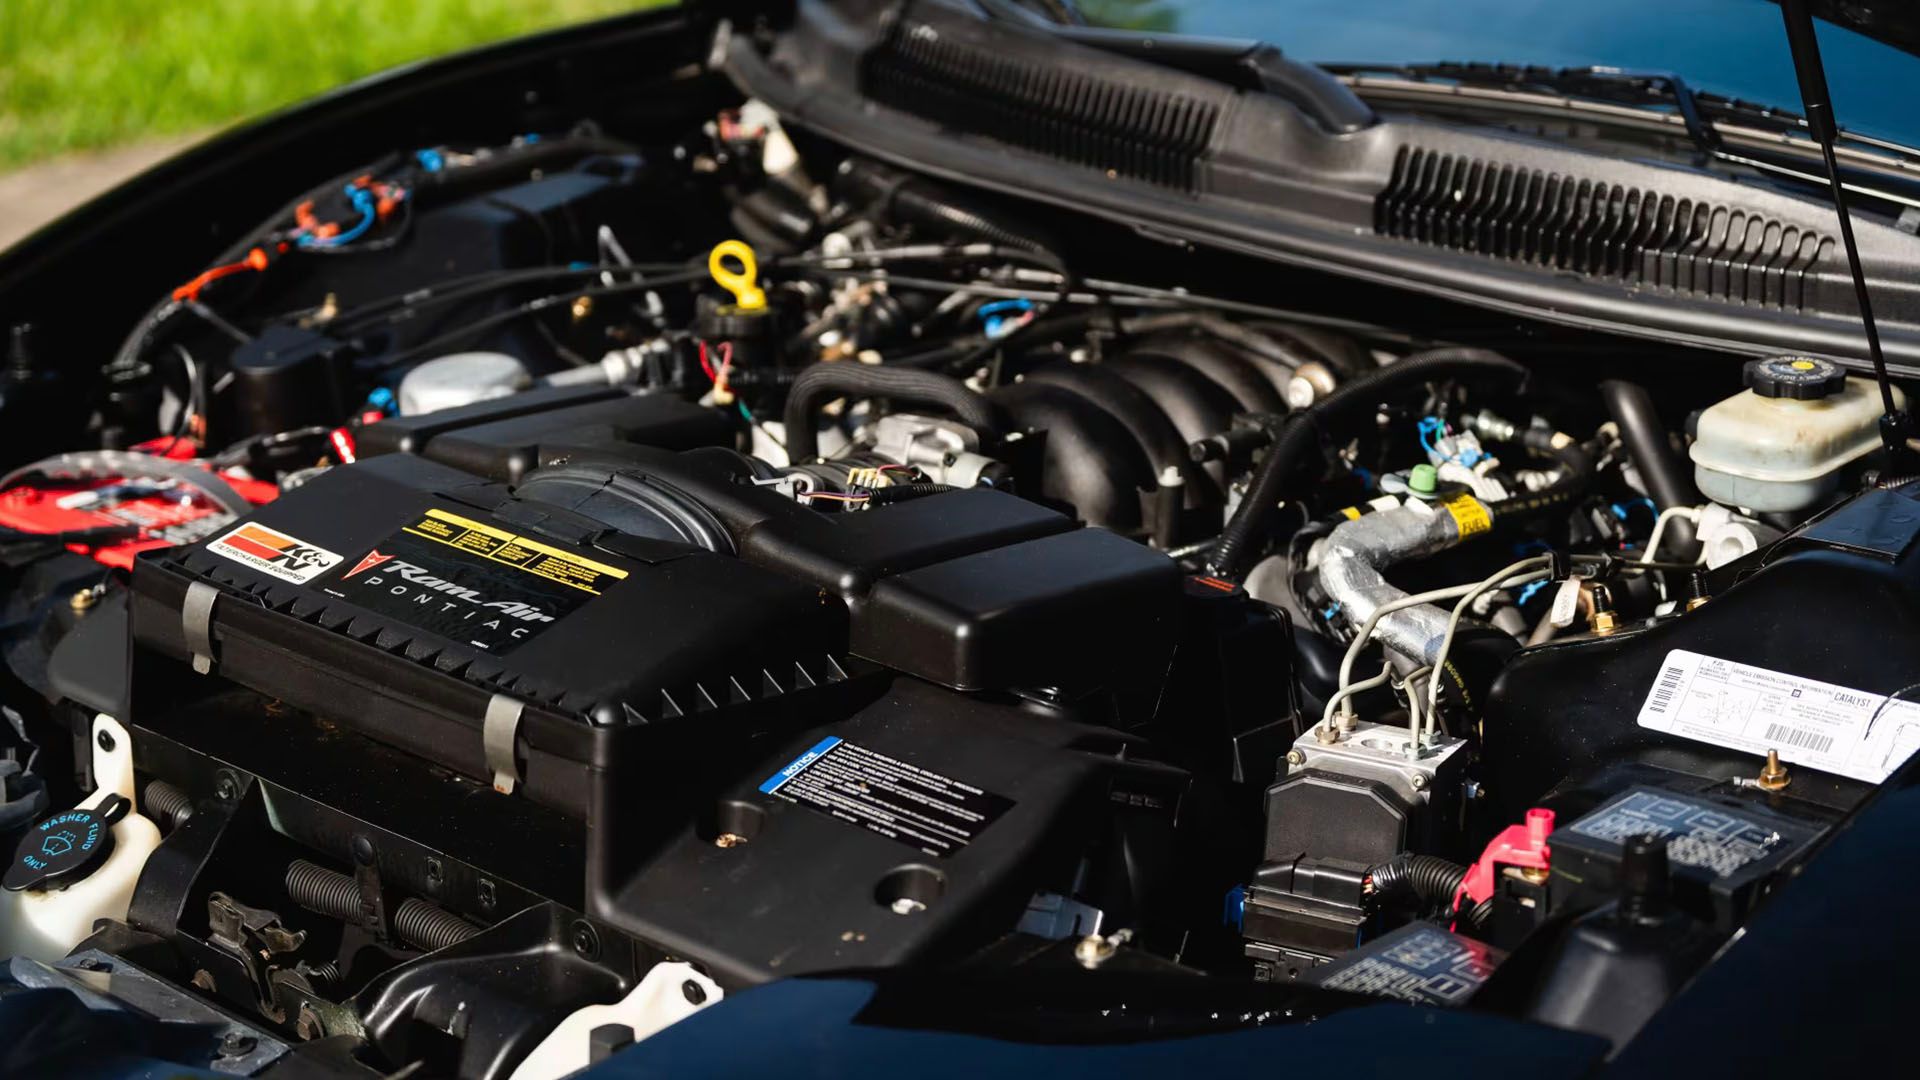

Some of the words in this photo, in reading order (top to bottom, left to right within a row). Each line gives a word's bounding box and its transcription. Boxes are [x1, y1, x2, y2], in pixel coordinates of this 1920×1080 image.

[1462, 518, 1488, 534] FUEL
[383, 560, 482, 603] Ram
[483, 601, 555, 622] Air
[364, 576, 529, 638] PONTIAC
[1834, 692, 1872, 708] CATALYST
[782, 751, 819, 777] NOTICE
[40, 813, 91, 831] WASHER
[82, 822, 98, 850] FLUID
[23, 855, 47, 870] ONLY
